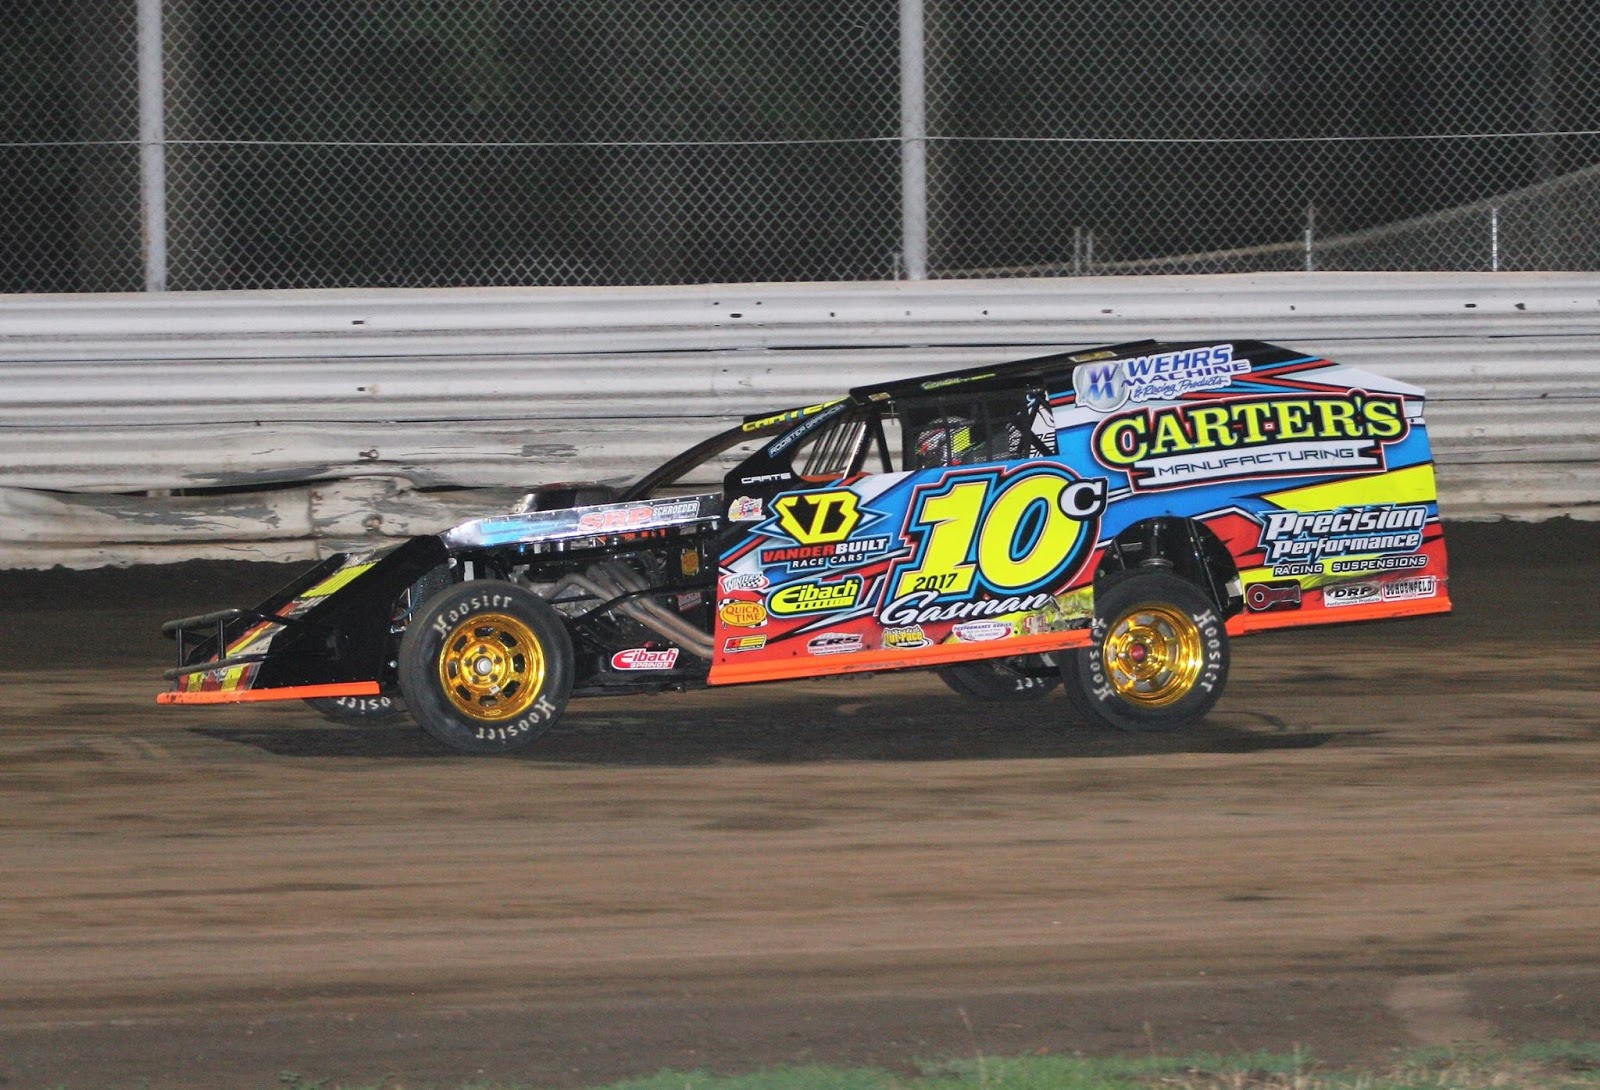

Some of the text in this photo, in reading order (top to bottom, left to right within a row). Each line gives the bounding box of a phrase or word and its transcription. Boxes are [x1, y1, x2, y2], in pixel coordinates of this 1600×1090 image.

[1121, 362, 1250, 387] MACHINE
[1127, 347, 1232, 377] WEHRS
[1100, 396, 1402, 465] CARTER'S
[1158, 447, 1354, 477] MANUFACTURING
[741, 473, 792, 485] CRATE
[581, 506, 654, 530] SRP
[652, 503, 698, 516] SCHROEDER
[1265, 506, 1425, 541] Precision
[763, 538, 888, 563] VANDERBUILT
[1271, 533, 1421, 559] Performance
[792, 553, 864, 568] RACE CARS
[1275, 556, 1428, 576] RACING SUSPENSIONS
[915, 573, 958, 591] 2017
[1335, 586, 1373, 598] DRP
[771, 578, 859, 613] Eibach
[433, 594, 513, 640] Hoosier
[726, 605, 760, 614] QUICK
[735, 612, 761, 623] TIME
[880, 591, 1051, 626] Gasman
[613, 650, 677, 668] Eibach
[1193, 608, 1222, 693] Hoosier
